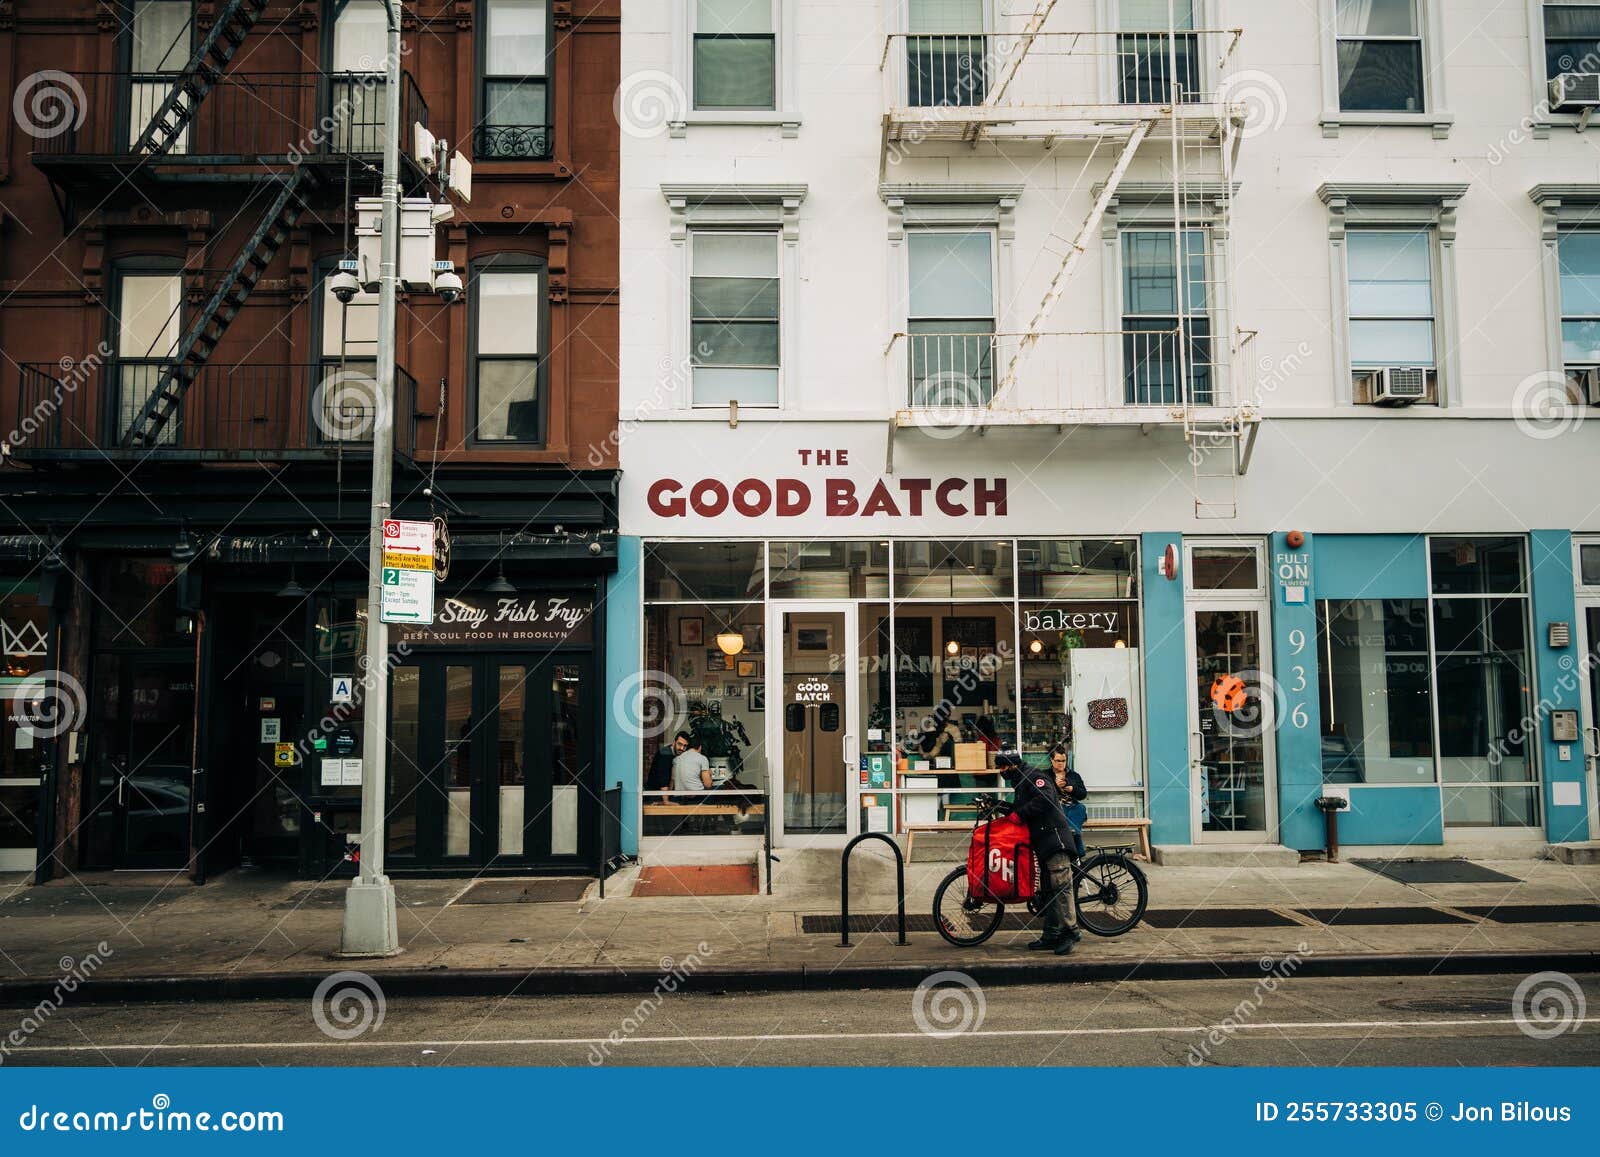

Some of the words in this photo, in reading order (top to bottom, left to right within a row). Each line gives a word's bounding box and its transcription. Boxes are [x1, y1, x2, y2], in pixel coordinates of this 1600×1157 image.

[798, 450, 849, 466] THE
[647, 478, 812, 518] GOOD
[826, 477, 1008, 517] BATCH
[1277, 553, 1310, 565] FULT
[387, 570, 396, 585] 2
[1279, 565, 1309, 580] ON
[494, 598, 540, 623] Fish
[1024, 609, 1119, 633] bakery
[403, 632, 429, 640] BEST
[433, 632, 461, 640] SOUL
[513, 631, 568, 639] BROOKLYN
[336, 681, 349, 695] A
[797, 683, 829, 692] GOOD
[795, 692, 831, 701] BATCH
[988, 848, 1015, 884] GH
